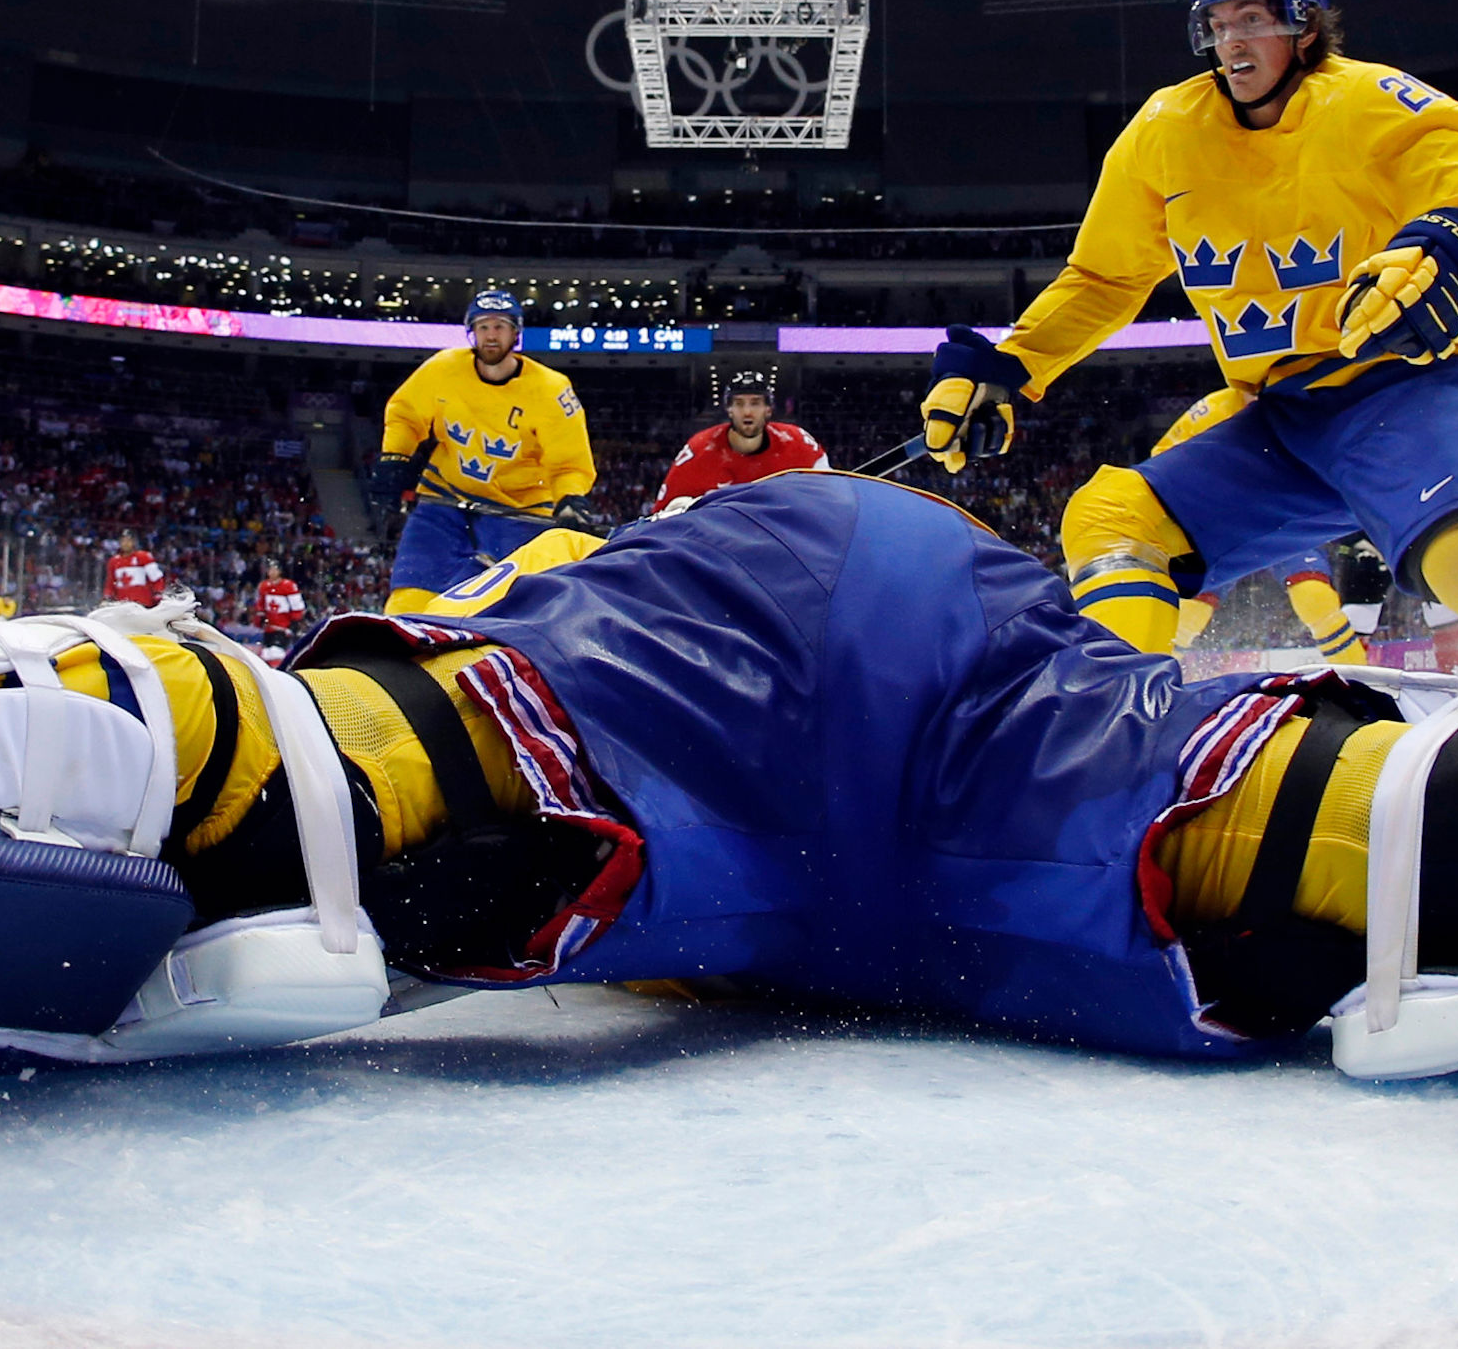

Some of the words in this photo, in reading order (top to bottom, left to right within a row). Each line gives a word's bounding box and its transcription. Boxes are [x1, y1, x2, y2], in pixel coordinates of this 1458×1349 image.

[581, 327, 596, 343] 0
[638, 327, 650, 344] 1
[654, 329, 684, 342] CAN
[507, 406, 524, 429] C
